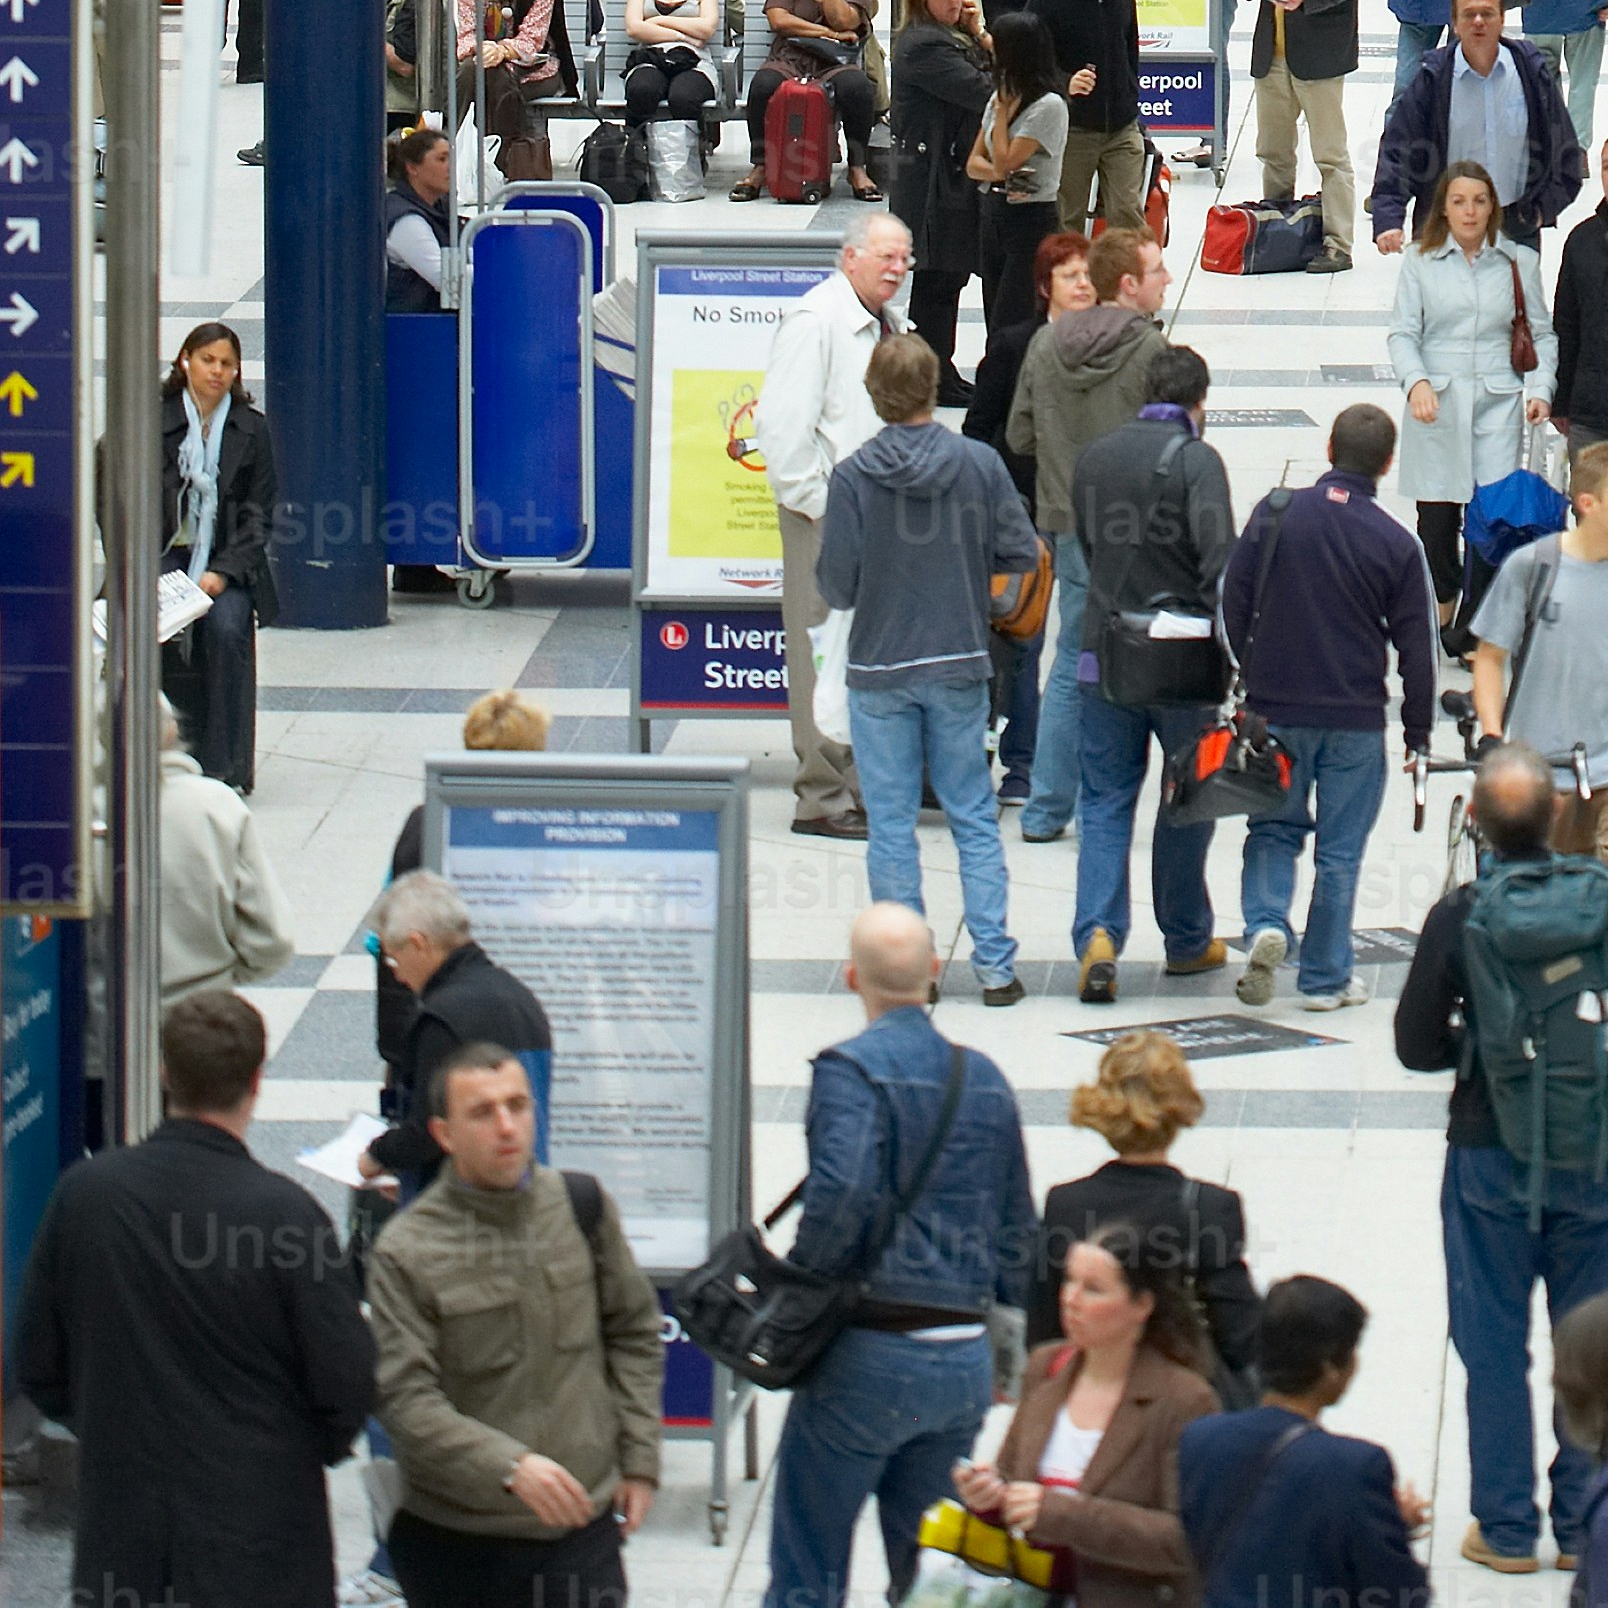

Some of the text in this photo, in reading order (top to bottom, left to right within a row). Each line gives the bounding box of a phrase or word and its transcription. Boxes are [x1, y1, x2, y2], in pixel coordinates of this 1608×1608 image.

[747, 270, 781, 283] Street
[783, 270, 823, 283] Station
[693, 305, 721, 323] No
[718, 567, 772, 579] Network
[704, 622, 787, 656] Liverp
